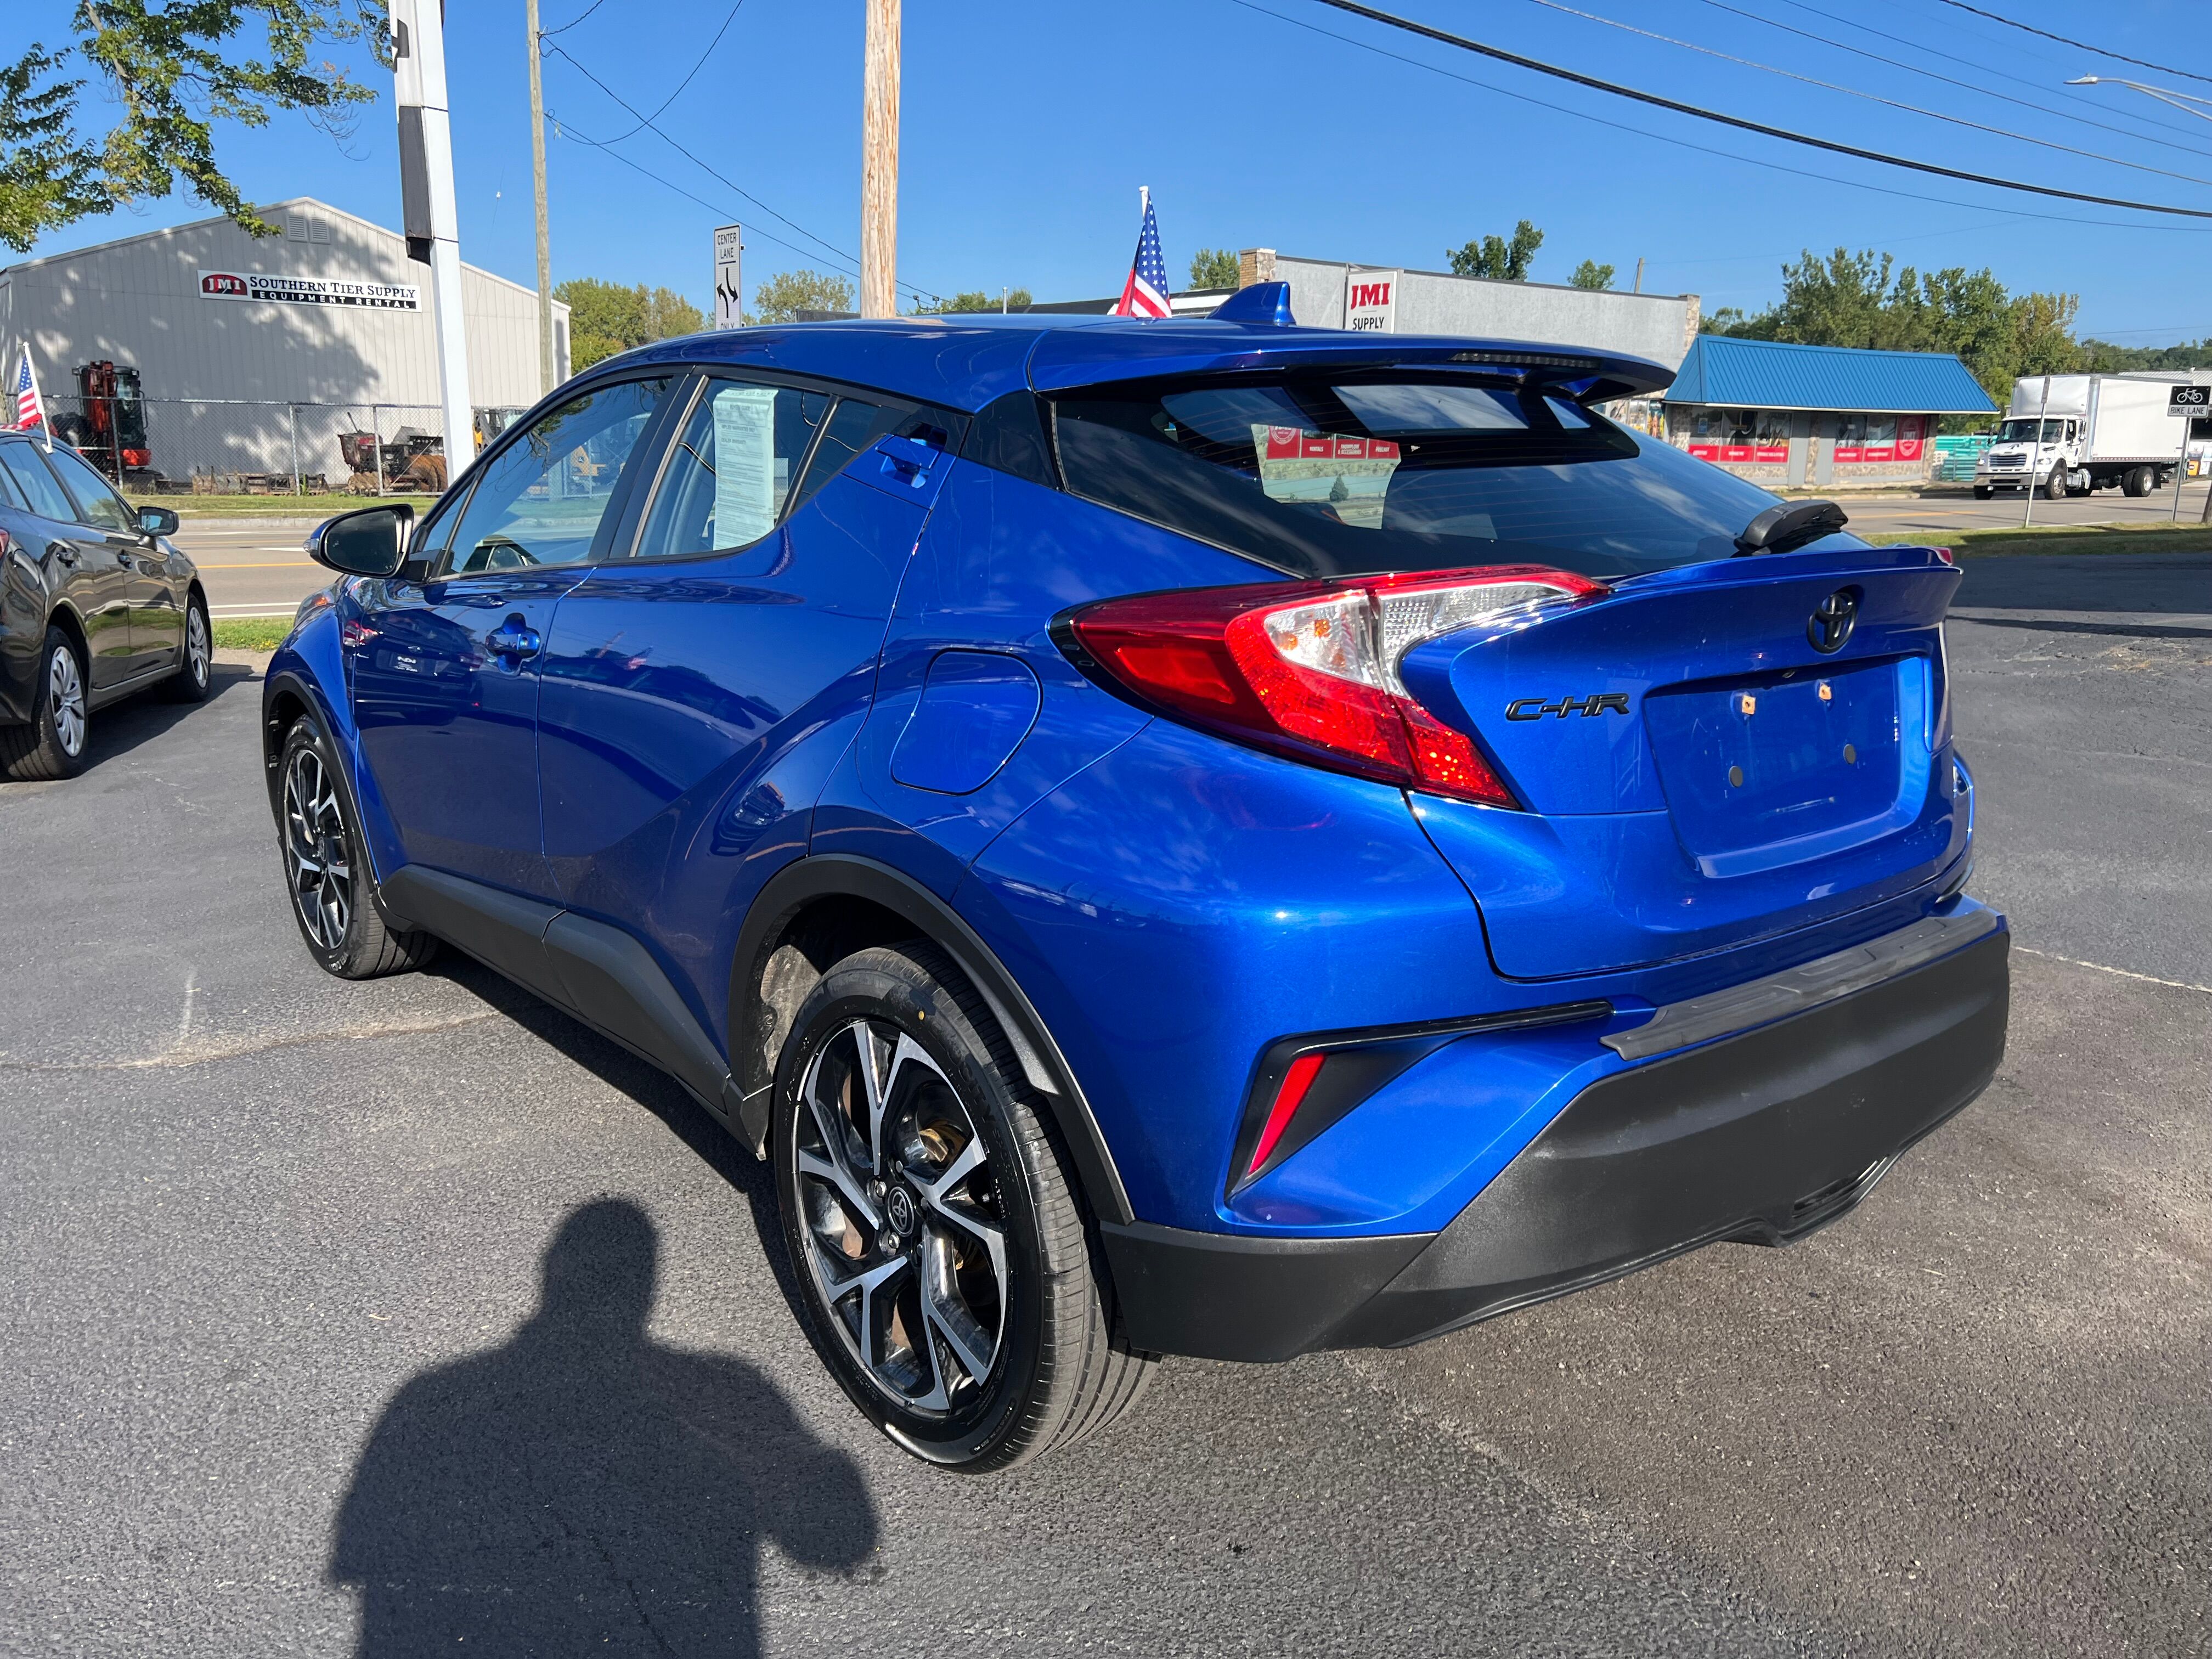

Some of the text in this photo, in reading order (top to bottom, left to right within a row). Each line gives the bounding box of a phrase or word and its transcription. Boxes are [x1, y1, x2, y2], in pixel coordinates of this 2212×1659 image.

[717, 232, 737, 245] CENTER
[720, 247, 734, 259] LANE
[208, 278, 243, 291] JMI
[250, 276, 416, 298] SOUTHERN TIER SUPPLY
[259, 291, 410, 308] EQUIPMENT RENTAL
[1350, 282, 1390, 310] JMI
[1352, 316, 1385, 330] SUPPLY
[1505, 693, 1630, 721] C-HR
